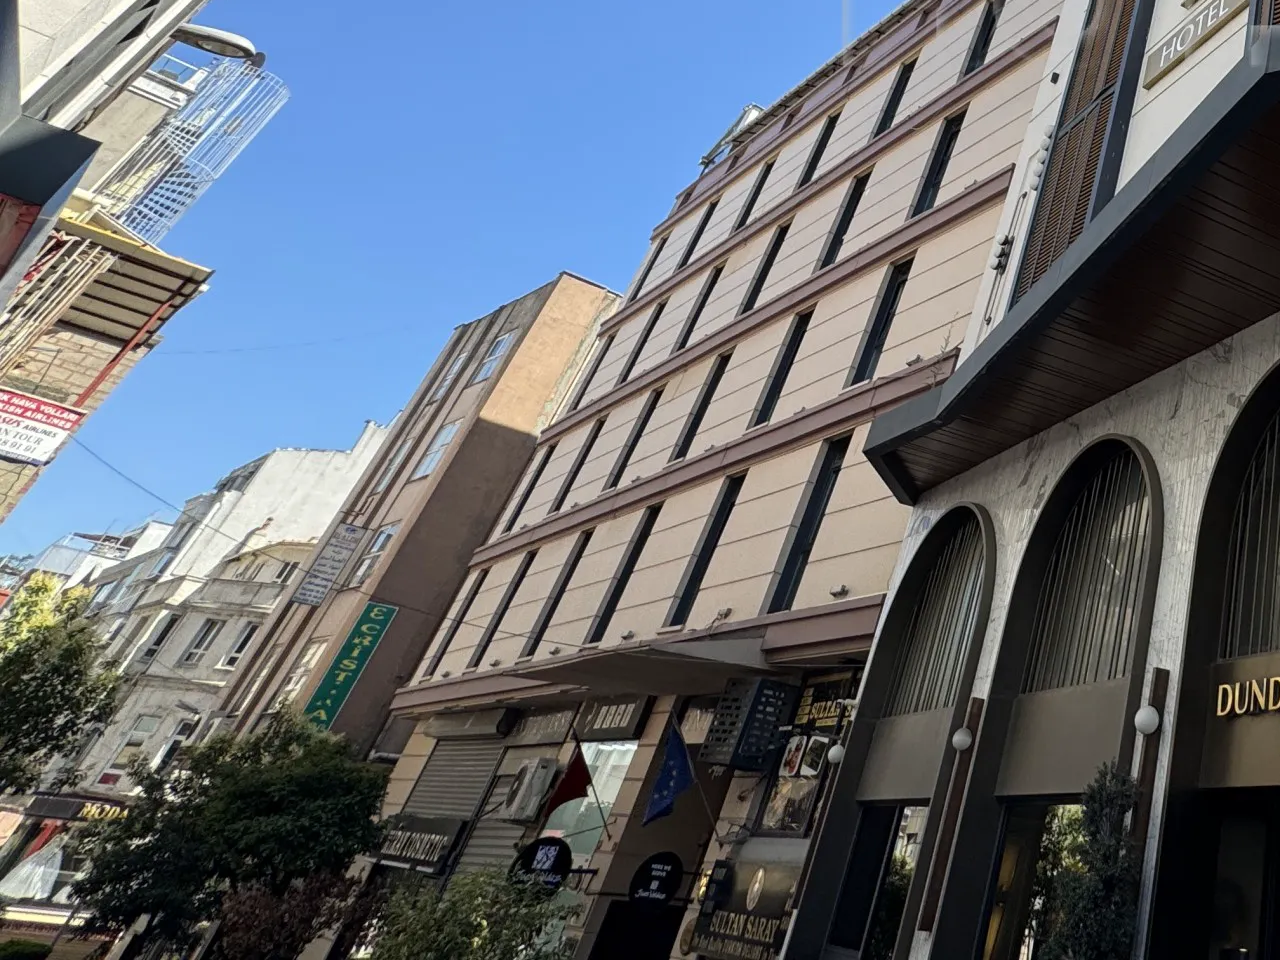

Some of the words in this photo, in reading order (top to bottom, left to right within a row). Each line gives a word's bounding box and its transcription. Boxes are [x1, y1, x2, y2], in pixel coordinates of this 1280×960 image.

[10, 396, 38, 410] HAVA
[39, 404, 81, 422] YOLLARI
[23, 410, 73, 430] AIRLINES
[13, 431, 43, 445] TOUR
[22, 424, 58, 438] AIRLINES
[76, 802, 129, 820] MODA
[709, 909, 747, 936] SULTAN
[744, 915, 780, 944] SARAY
